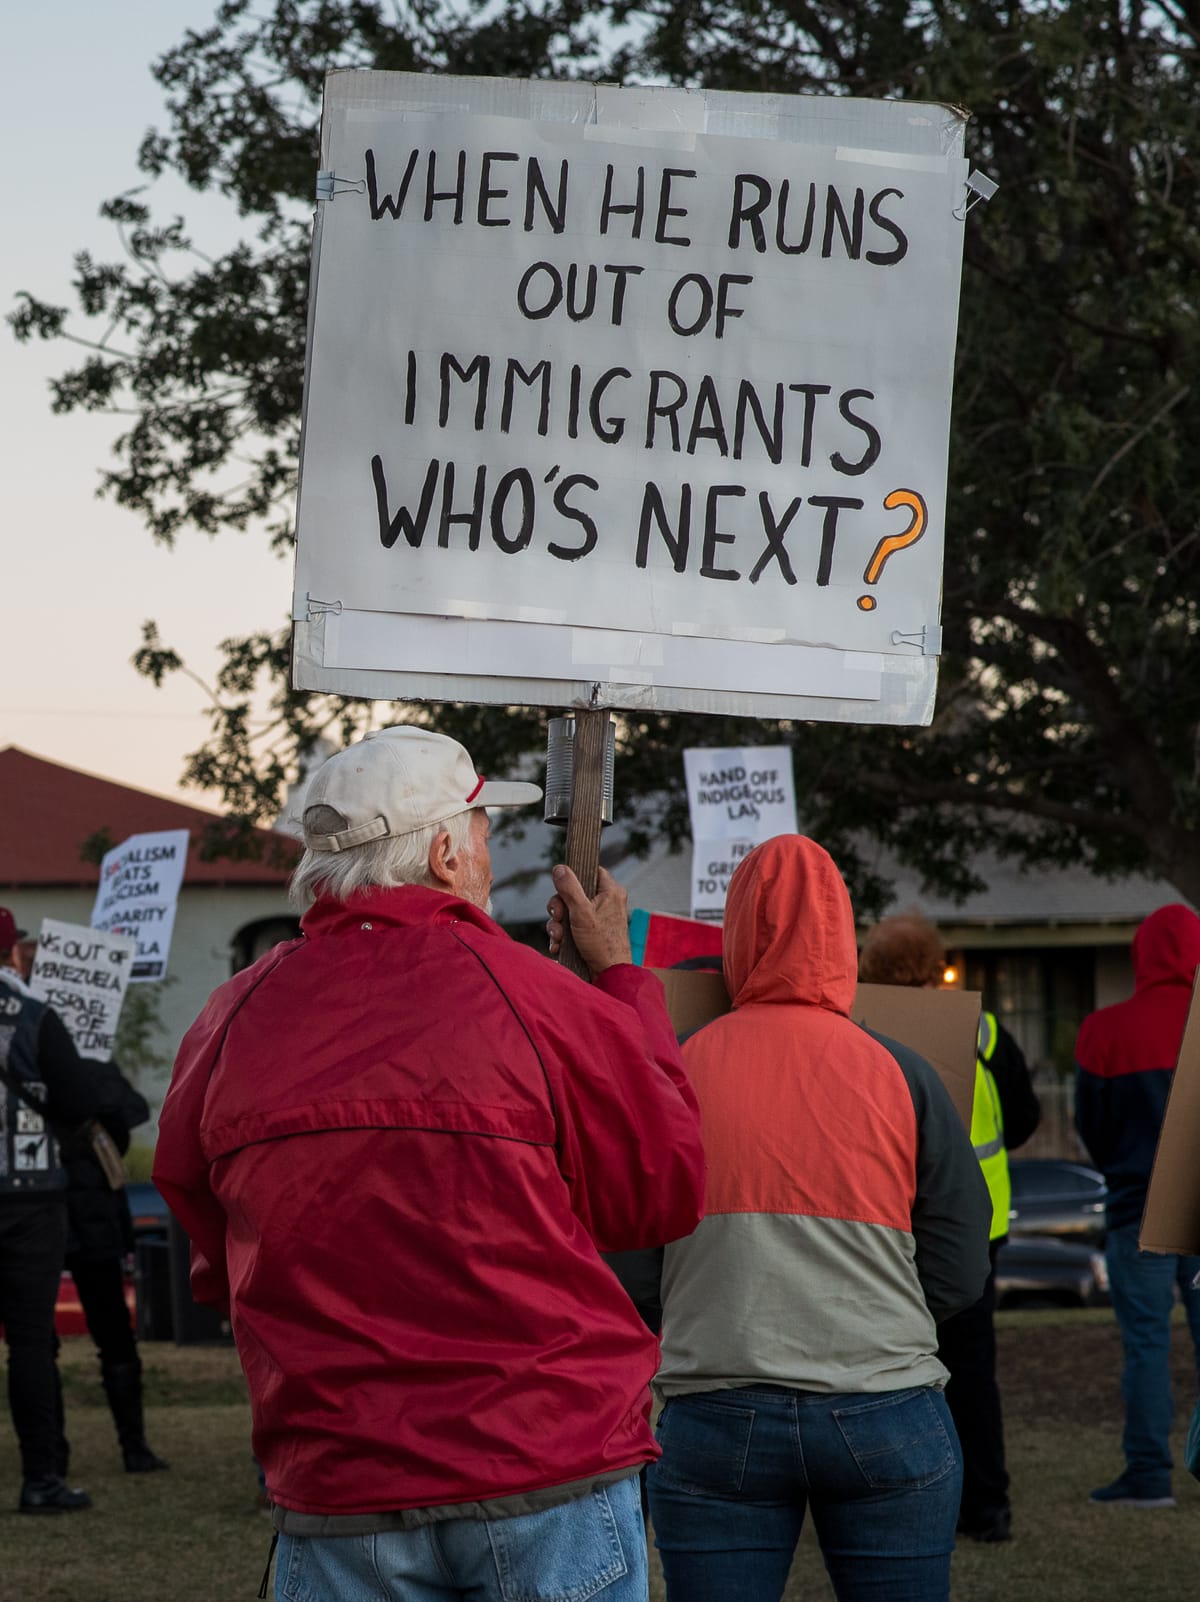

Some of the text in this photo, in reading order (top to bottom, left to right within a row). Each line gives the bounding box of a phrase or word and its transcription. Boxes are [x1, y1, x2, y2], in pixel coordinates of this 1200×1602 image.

[365, 149, 909, 266] WHEN HE RUNS
[517, 261, 754, 339] OUT OF
[404, 350, 882, 476] IMMIGRANTS
[370, 454, 929, 612] WHO'S NEXT?
[751, 770, 779, 786] OFF
[697, 880, 717, 894] TO
[63, 940, 106, 962] OUT
[108, 950, 130, 966] OF
